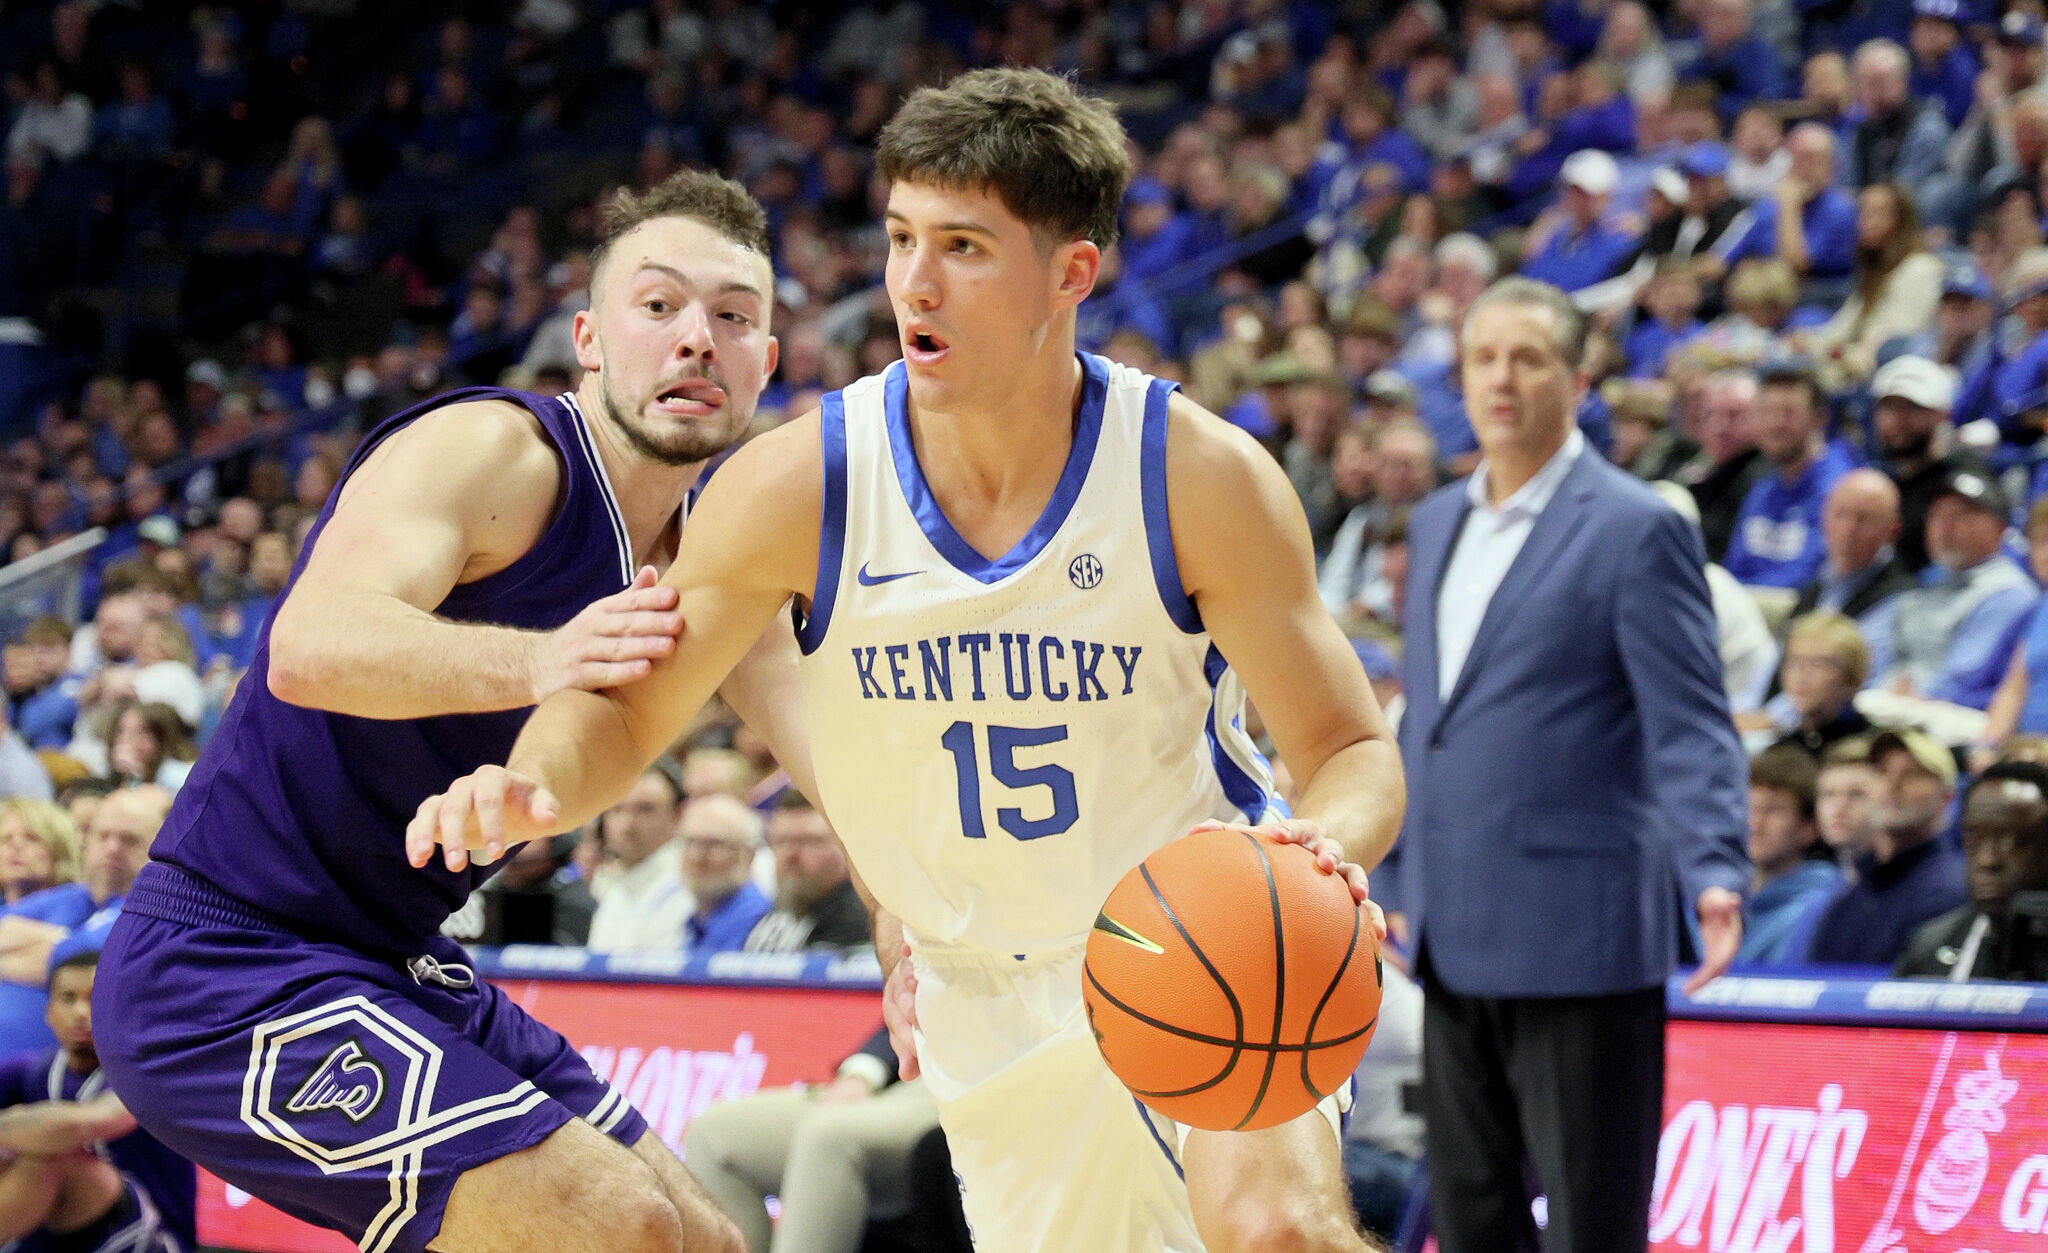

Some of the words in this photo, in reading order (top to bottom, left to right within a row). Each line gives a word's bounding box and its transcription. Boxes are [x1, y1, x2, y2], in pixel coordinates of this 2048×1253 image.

[1069, 554, 1103, 589] SEC
[852, 633, 1142, 702] KENTUCKY
[941, 720, 1079, 841] 15
